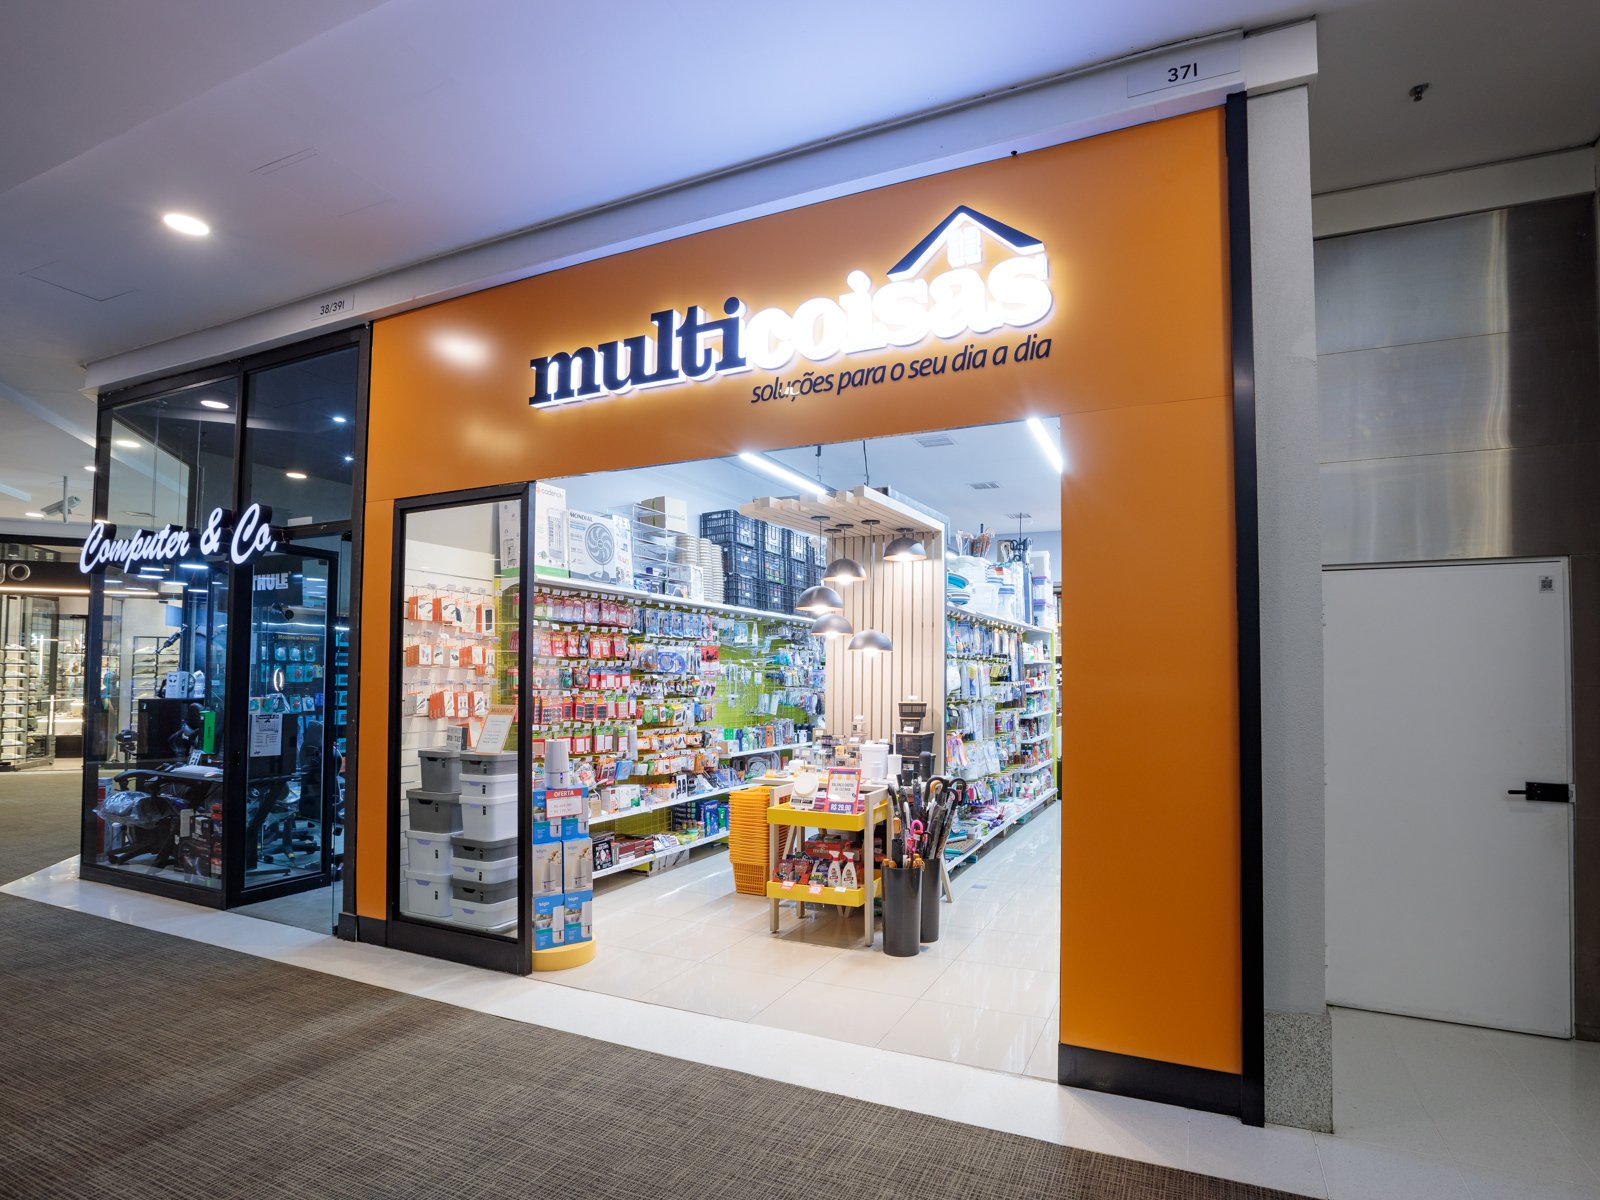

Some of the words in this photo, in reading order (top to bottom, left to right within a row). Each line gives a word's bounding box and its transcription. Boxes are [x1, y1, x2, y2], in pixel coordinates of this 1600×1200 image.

[528, 255, 1053, 410] multicoisas
[750, 371, 835, 403] soluções
[836, 364, 887, 395] para
[889, 361, 905, 382] o
[907, 354, 948, 380] seu
[951, 343, 987, 373] dia
[991, 345, 1009, 366] a
[1013, 333, 1053, 363] dia
[79, 521, 191, 574] Computer
[199, 506, 223, 556] &
[230, 502, 278, 565] Co.
[252, 572, 289, 591] THULE
[553, 790, 575, 798] OFERTA
